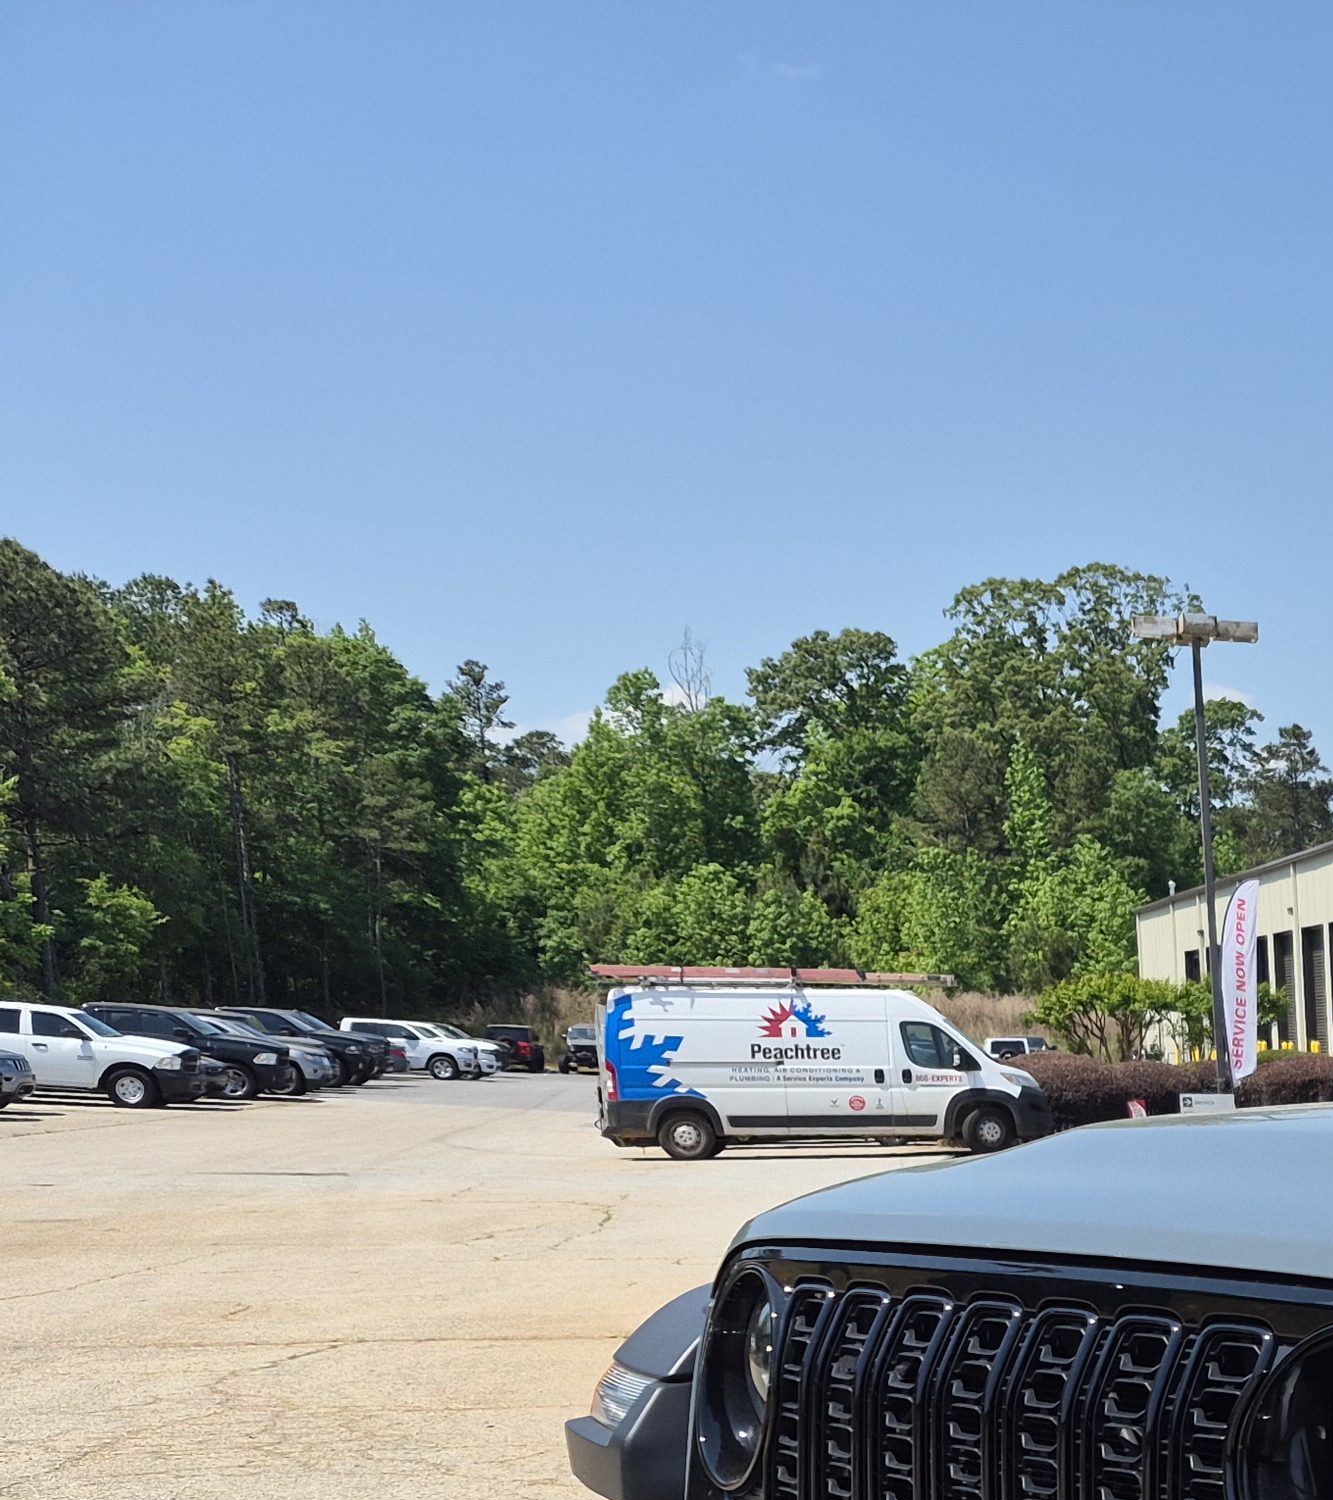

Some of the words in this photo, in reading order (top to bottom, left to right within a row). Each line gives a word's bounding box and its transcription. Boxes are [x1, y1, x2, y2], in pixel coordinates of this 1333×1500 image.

[1236, 898, 1247, 945] OPEN
[1235, 951, 1247, 993] NOW
[750, 1043, 842, 1060] Peachtree
[1233, 997, 1247, 1070] SERVICE
[808, 1075, 833, 1083] Experts
[834, 1075, 865, 1083] Company
